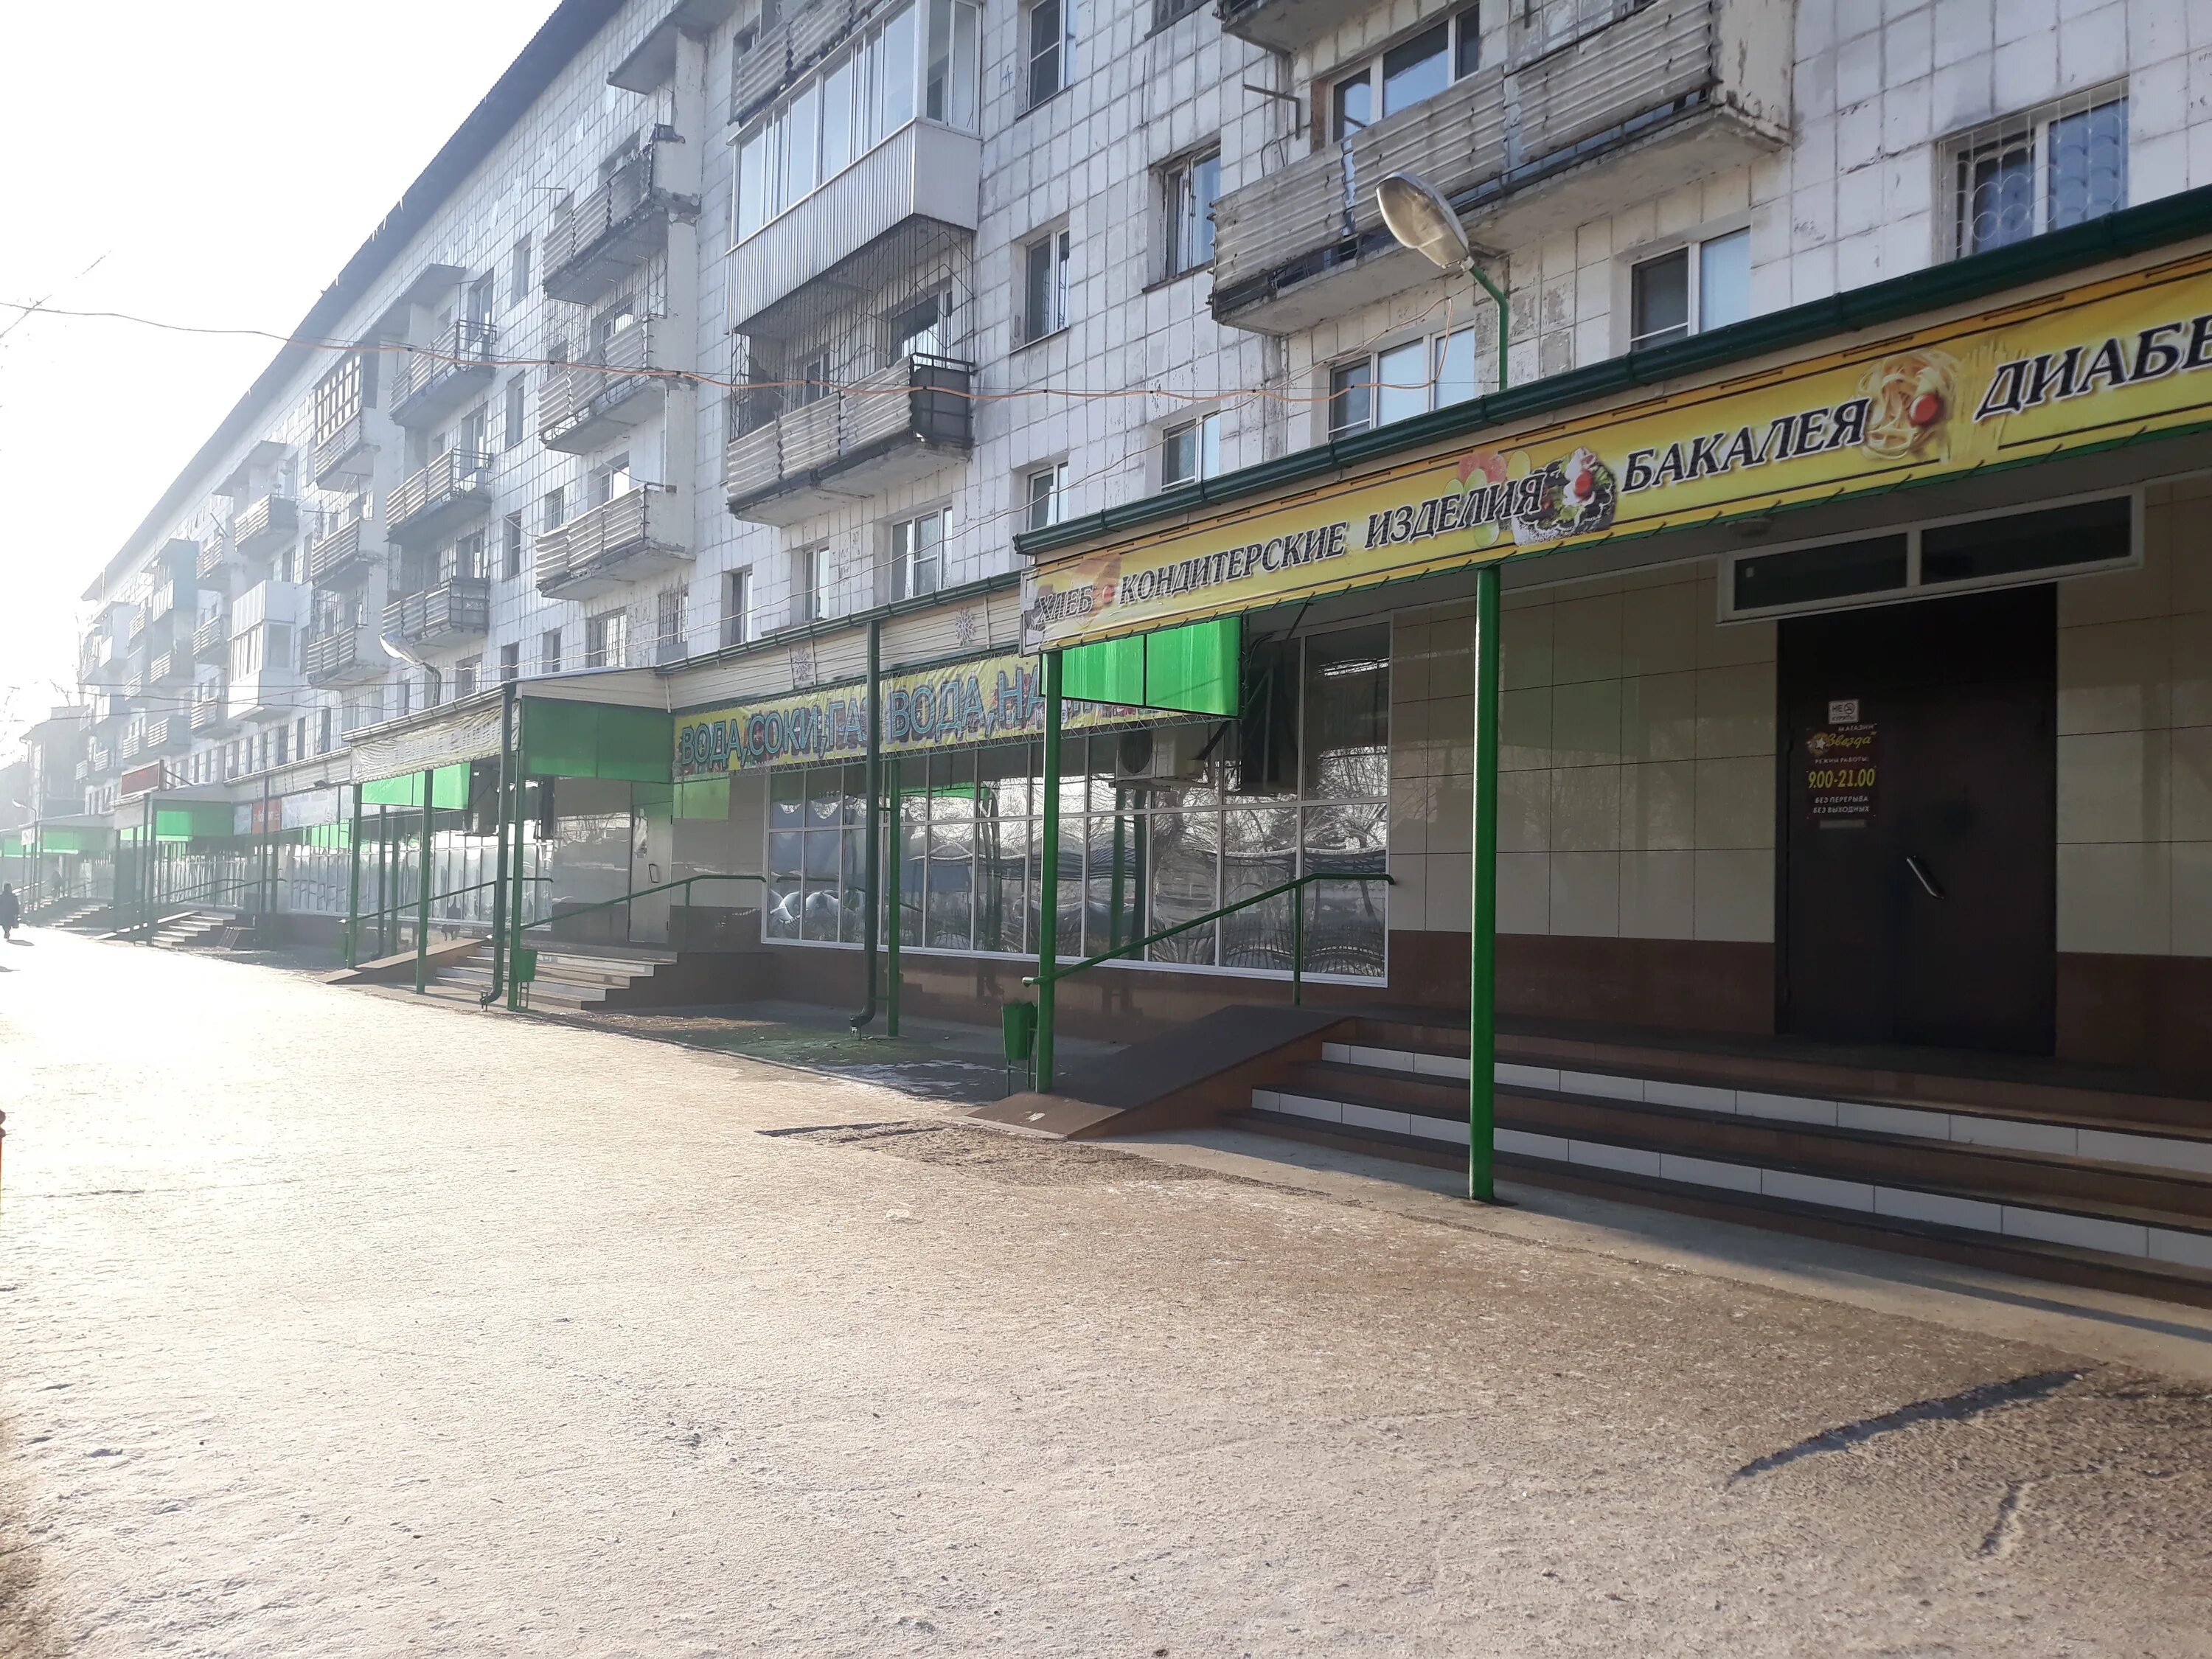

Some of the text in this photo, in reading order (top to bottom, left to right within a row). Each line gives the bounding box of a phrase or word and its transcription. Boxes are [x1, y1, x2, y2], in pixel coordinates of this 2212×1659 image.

[1036, 585, 1096, 625] ХЛЕБ
[1119, 521, 1348, 605] КОНДИТЕРСКИЕ
[1363, 472, 1548, 551] ИЗДЕЛИЯ
[1621, 396, 1872, 493] БАКАЛЕЯ
[1832, 705, 1843, 714] НЕ
[1827, 805, 1870, 813] ВЫХОДНЫХ
